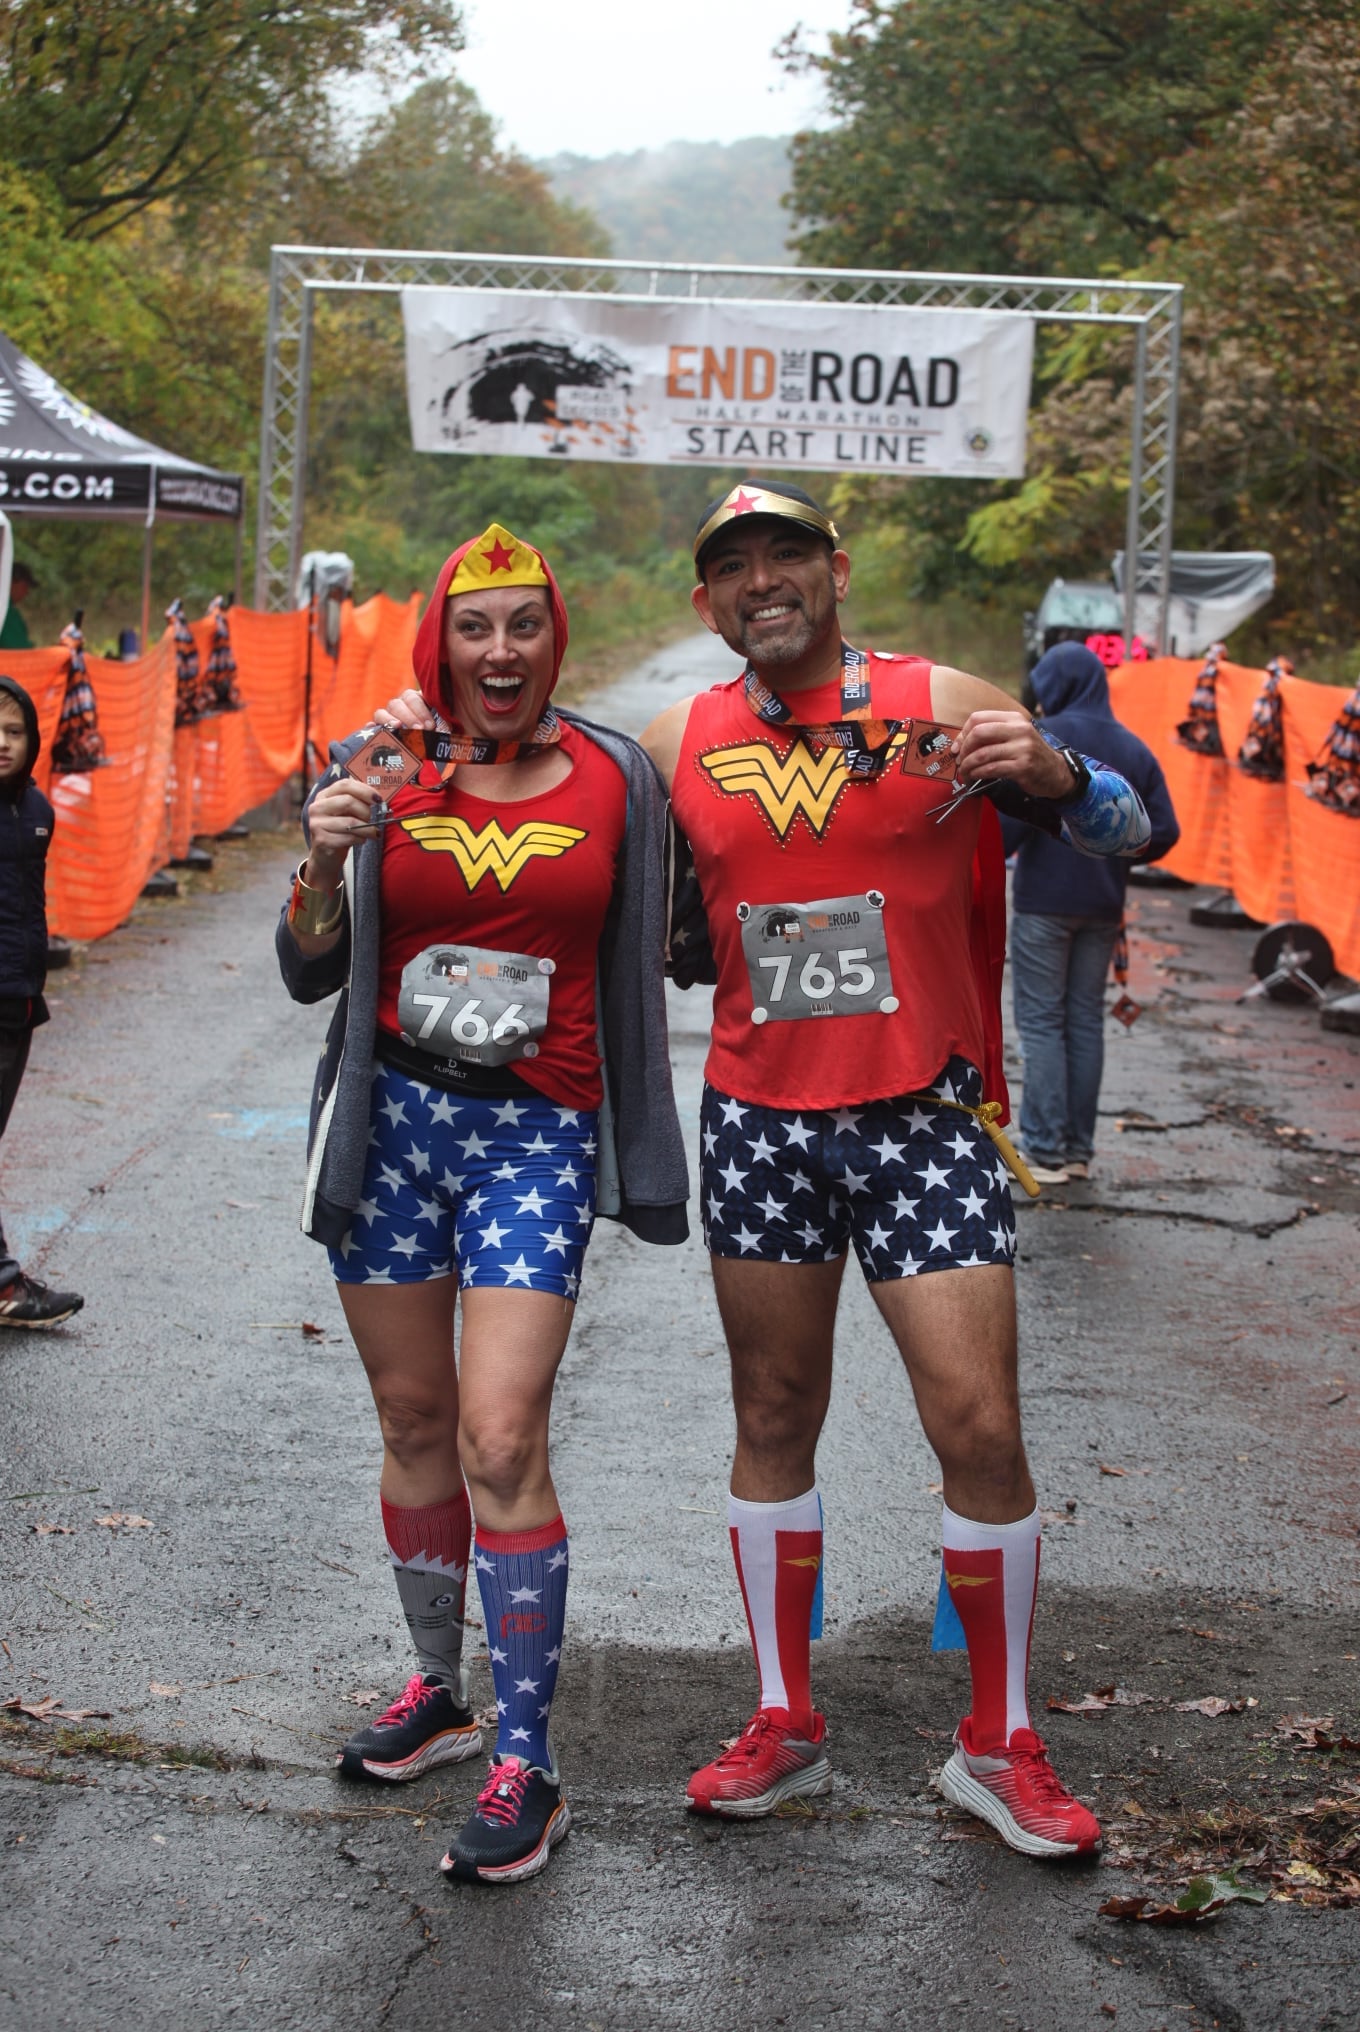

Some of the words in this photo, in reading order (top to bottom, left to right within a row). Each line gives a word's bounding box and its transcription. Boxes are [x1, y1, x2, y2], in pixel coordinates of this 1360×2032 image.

[666, 346, 776, 401] END
[781, 349, 806, 376] THE
[781, 382, 804, 402] OF
[811, 350, 960, 408] ROAD
[696, 406, 761, 420] HALF
[777, 409, 921, 427] MARATHON
[686, 427, 814, 457] START
[835, 433, 926, 464] LINE
[754, 687, 782, 716] ROAD
[535, 710, 558, 743] ROAD
[436, 741, 465, 759] ROAD
[833, 911, 860, 926] ROAD
[503, 966, 528, 982] ROAD
[758, 948, 876, 1002] 765
[412, 993, 531, 1046] 766
[433, 1064, 467, 1079] FLIPBELT
